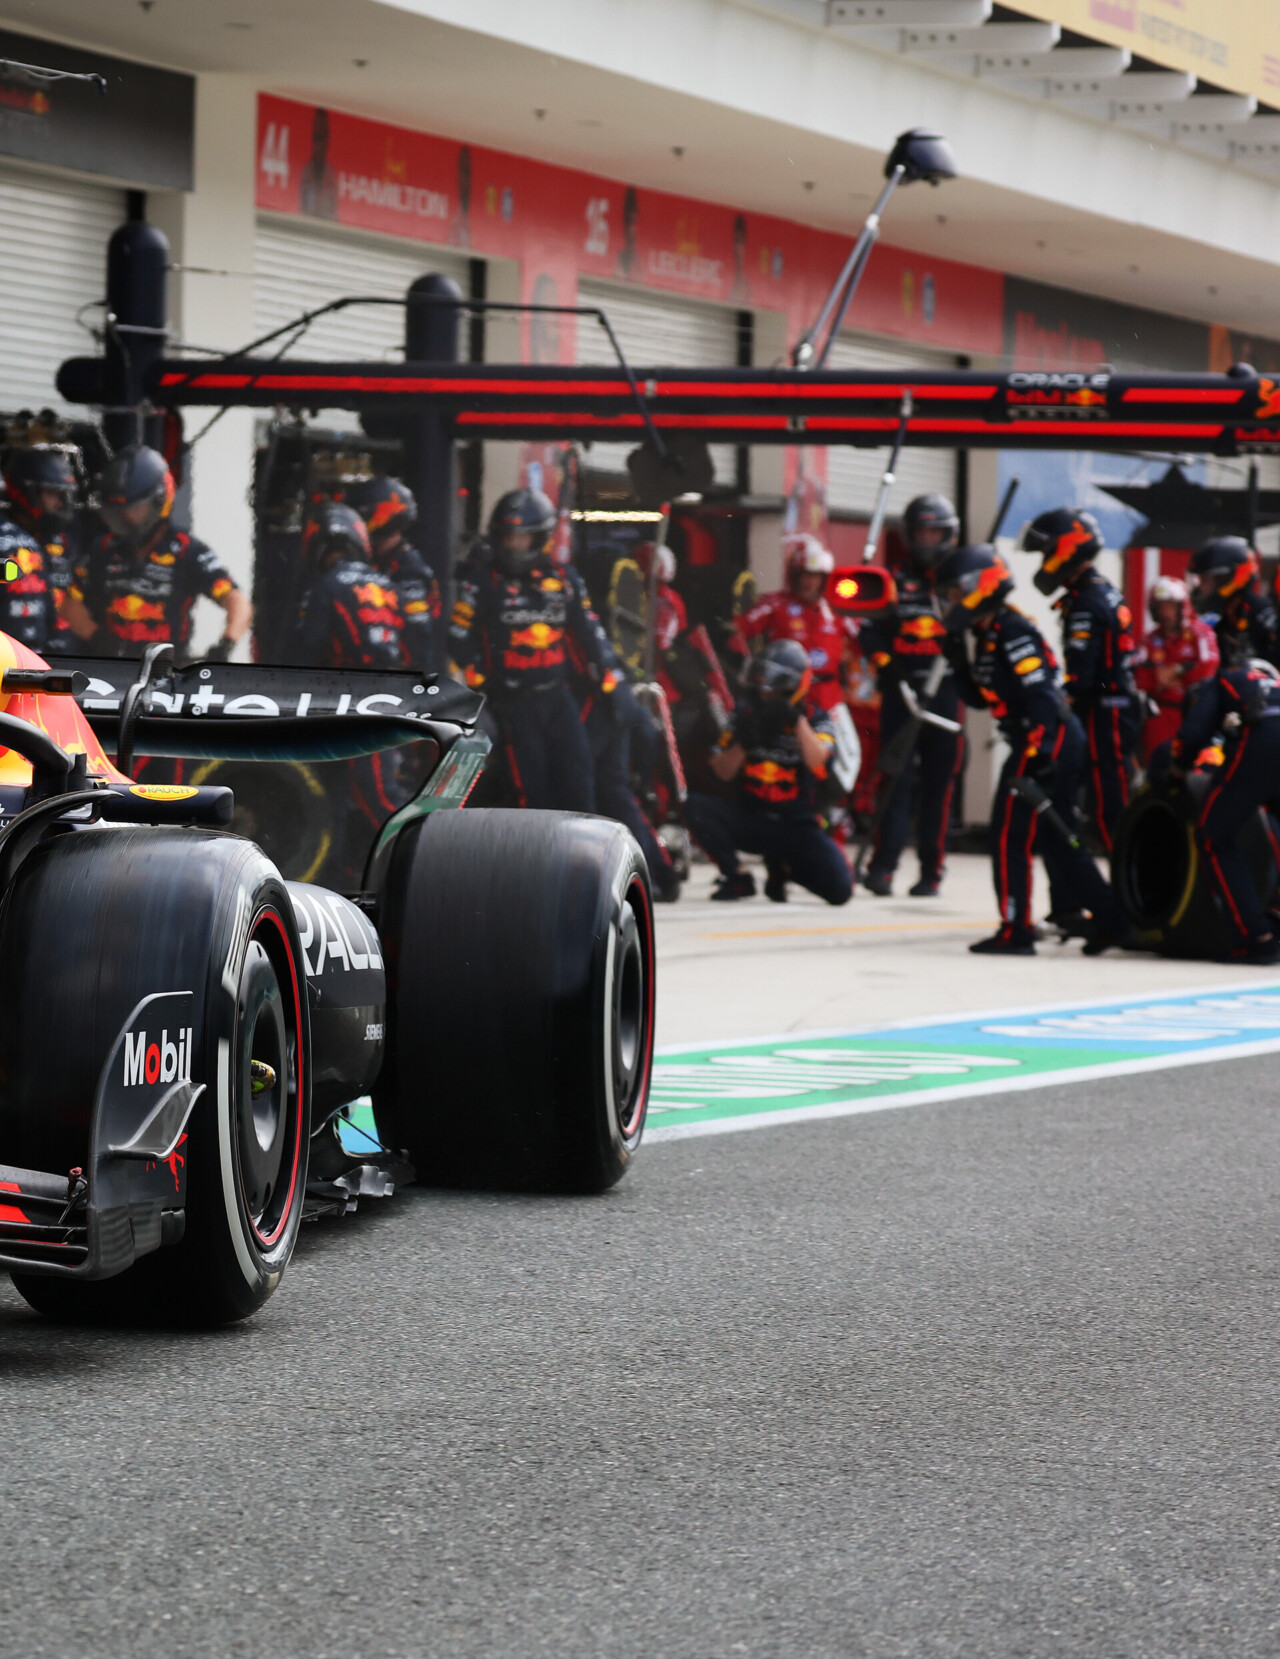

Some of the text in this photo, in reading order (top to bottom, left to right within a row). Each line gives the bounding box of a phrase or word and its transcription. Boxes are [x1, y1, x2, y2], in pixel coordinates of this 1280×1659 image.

[338, 172, 449, 219] HAMILTON
[1007, 373, 1111, 388] ORACLE
[147, 786, 190, 794] RAUCH
[123, 1027, 193, 1087] Mobil
